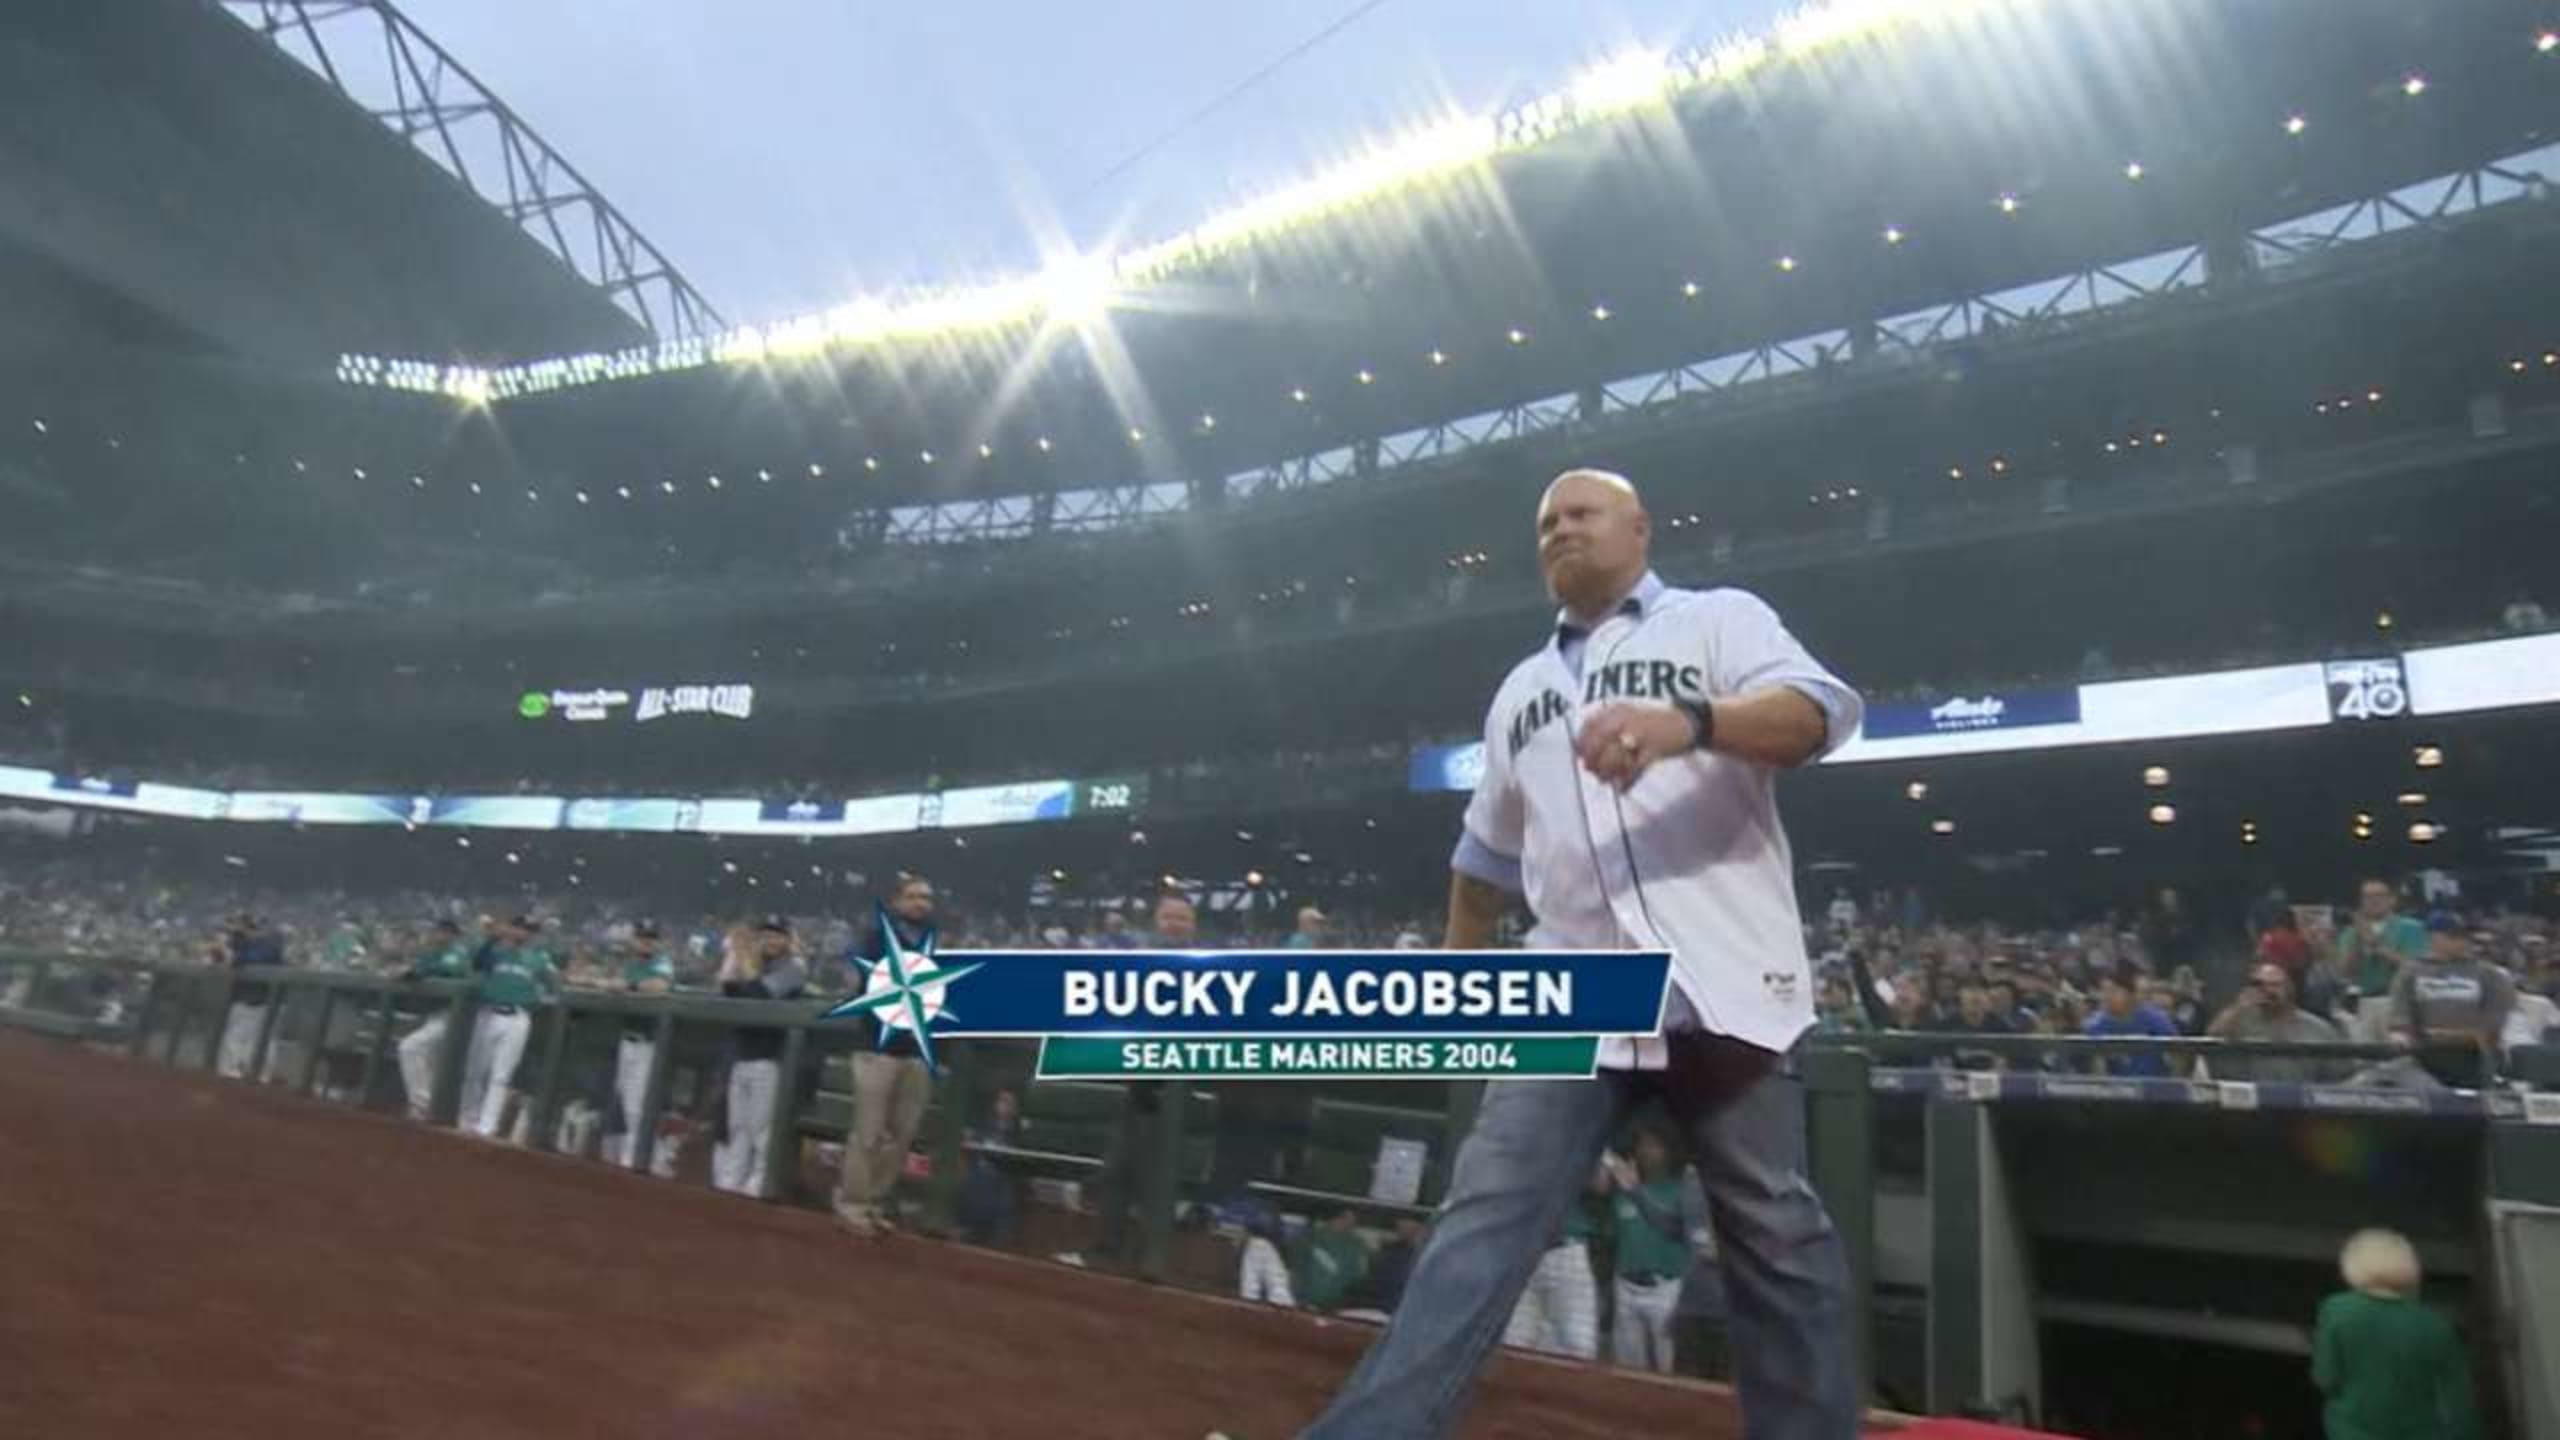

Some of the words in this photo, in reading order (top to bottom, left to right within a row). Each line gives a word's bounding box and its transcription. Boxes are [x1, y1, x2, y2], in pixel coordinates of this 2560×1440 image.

[711, 685, 752, 719] CLUB
[1508, 660, 1702, 757] MARINERS
[2338, 683, 2404, 719] 40
[1090, 784, 1130, 808] 7:02
